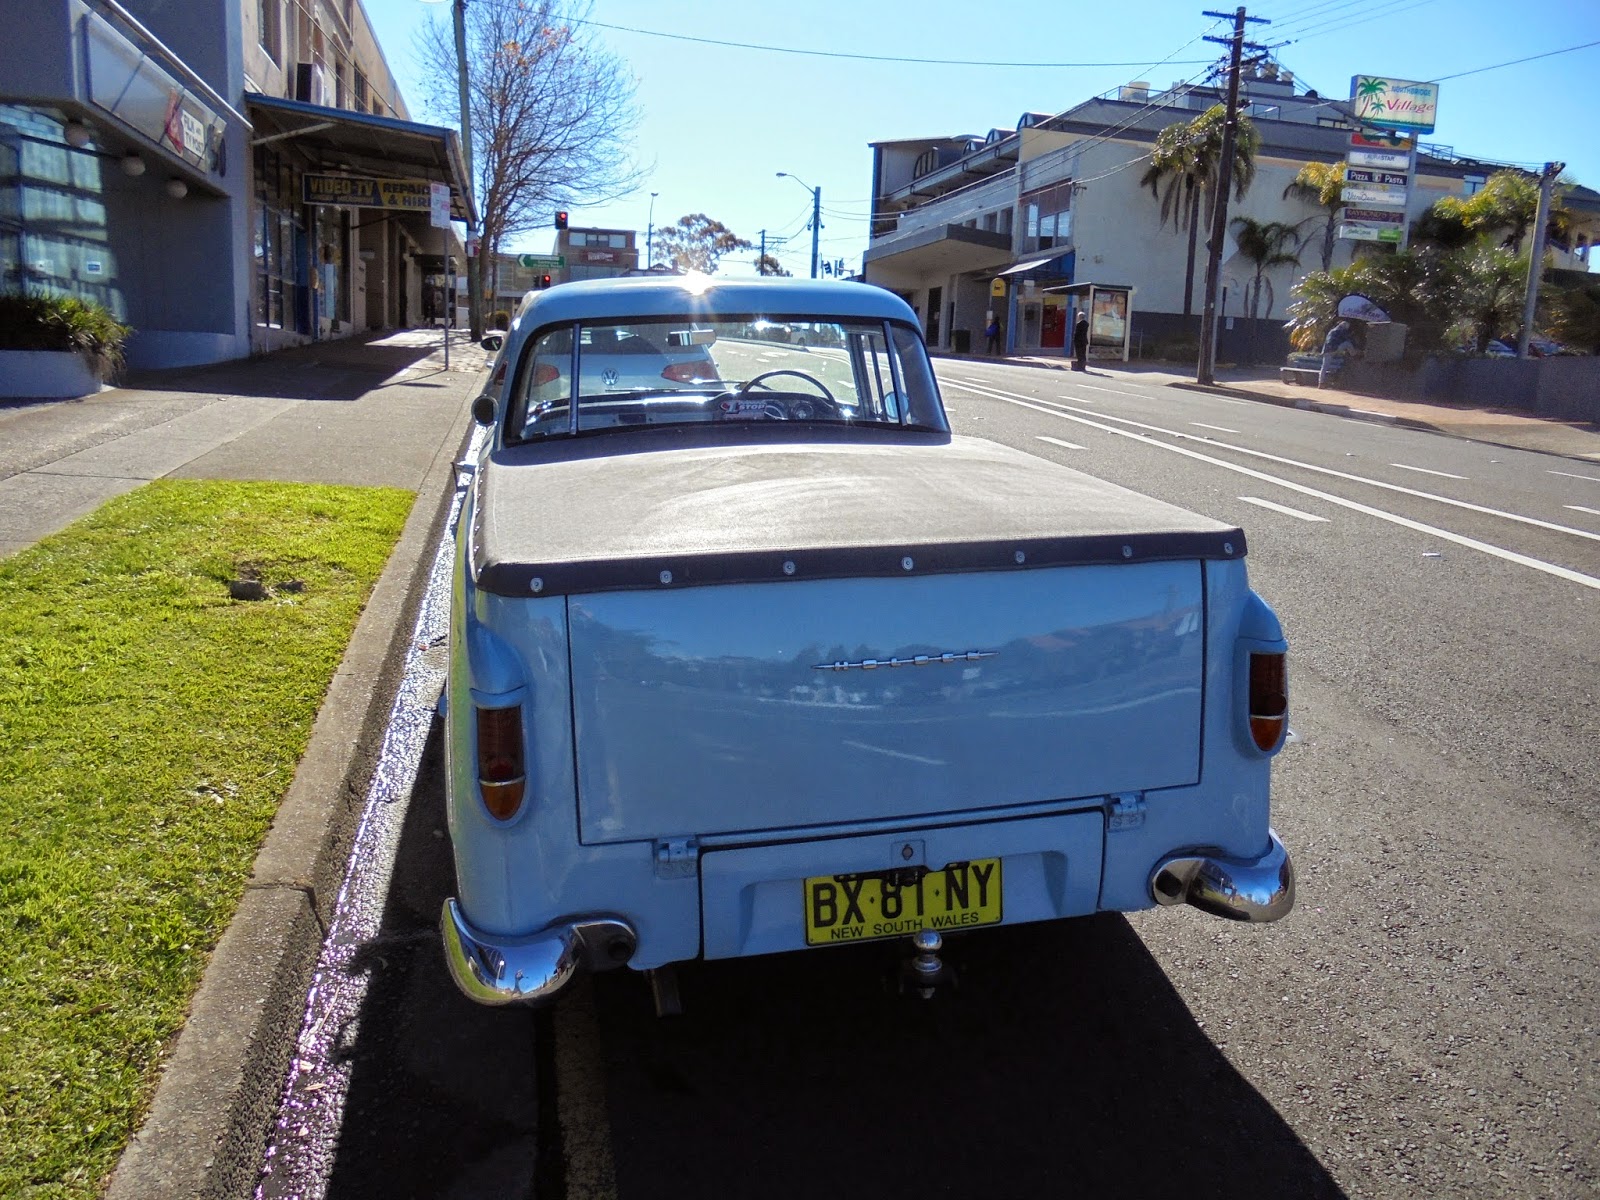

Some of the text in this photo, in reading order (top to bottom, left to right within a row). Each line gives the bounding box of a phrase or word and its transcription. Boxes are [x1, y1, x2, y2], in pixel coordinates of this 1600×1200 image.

[1387, 99, 1434, 113] Village
[1350, 171, 1404, 185] PIZZA PASTA
[830, 911, 979, 940] NEW SOUTH WALES
